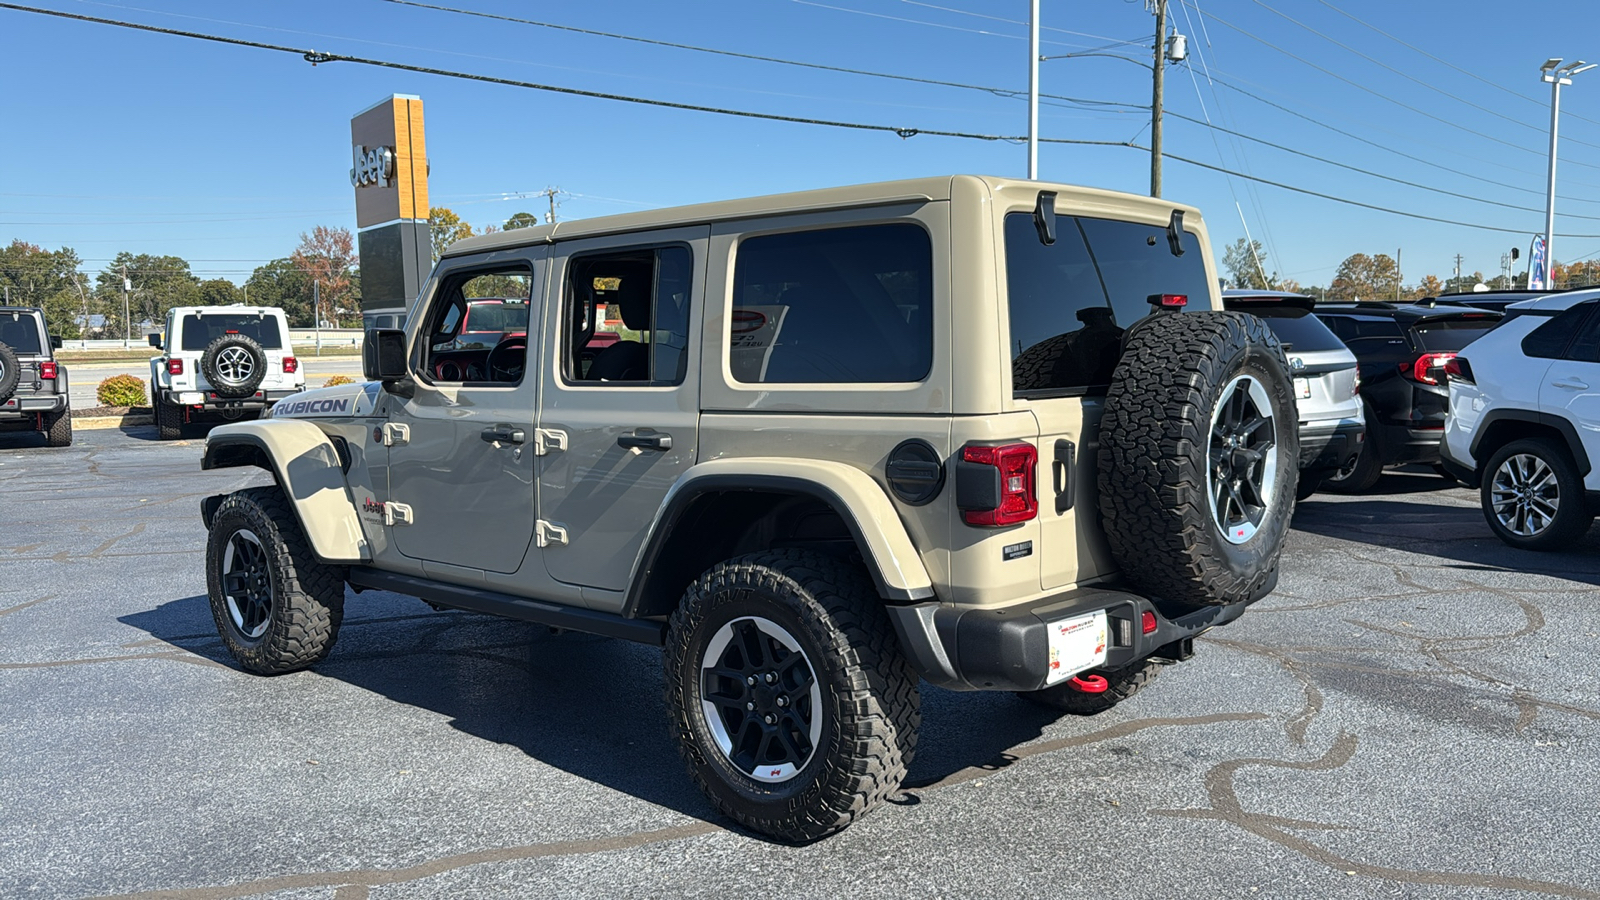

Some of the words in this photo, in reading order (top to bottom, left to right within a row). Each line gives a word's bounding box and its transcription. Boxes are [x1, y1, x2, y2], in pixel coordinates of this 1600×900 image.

[350, 145, 392, 188] Jeep
[274, 399, 348, 416] RUBICON
[363, 497, 386, 517] Jeep
